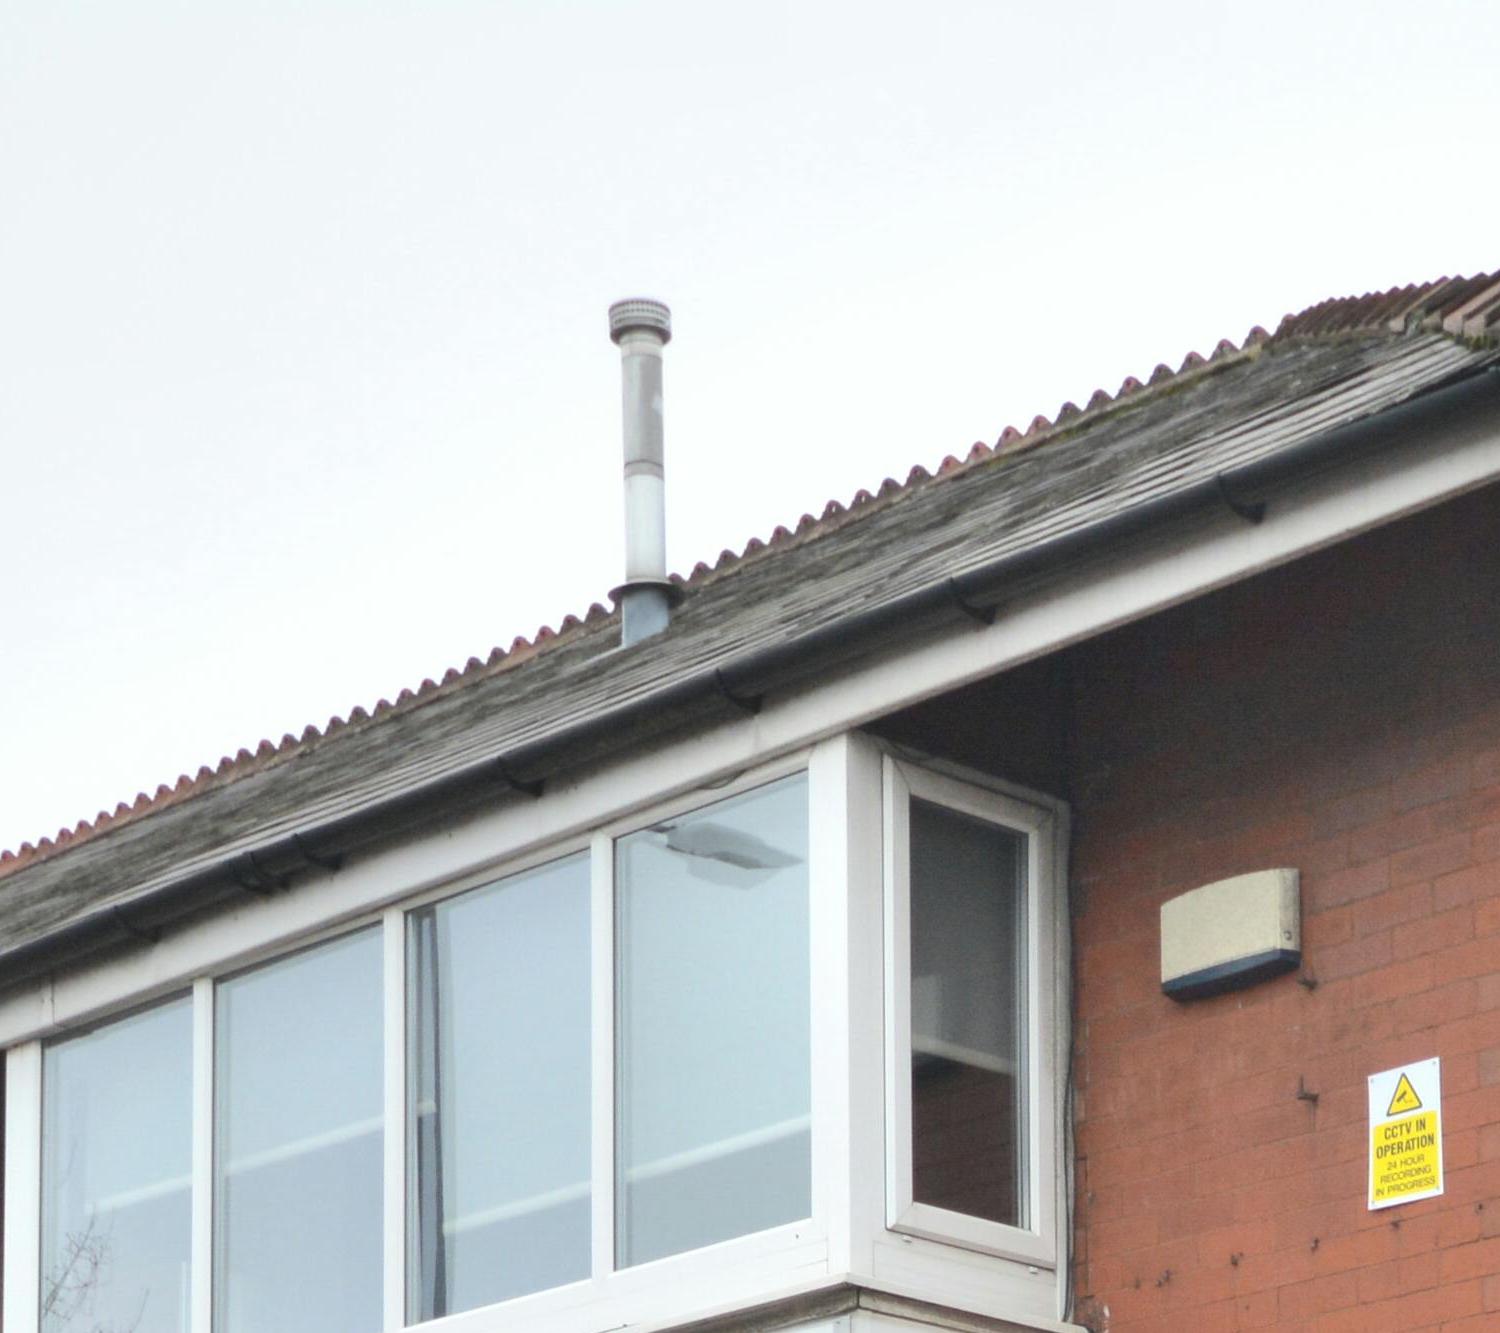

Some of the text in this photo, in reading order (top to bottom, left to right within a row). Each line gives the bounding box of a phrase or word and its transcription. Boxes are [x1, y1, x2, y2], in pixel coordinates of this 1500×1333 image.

[1384, 1117, 1427, 1140] CCTV IN
[1376, 1133, 1435, 1160] OPERATION
[1387, 1153, 1425, 1171] 24 HOUR
[1380, 1164, 1432, 1185] RECORDING
[1375, 1175, 1437, 1197] IN PROGRESS
